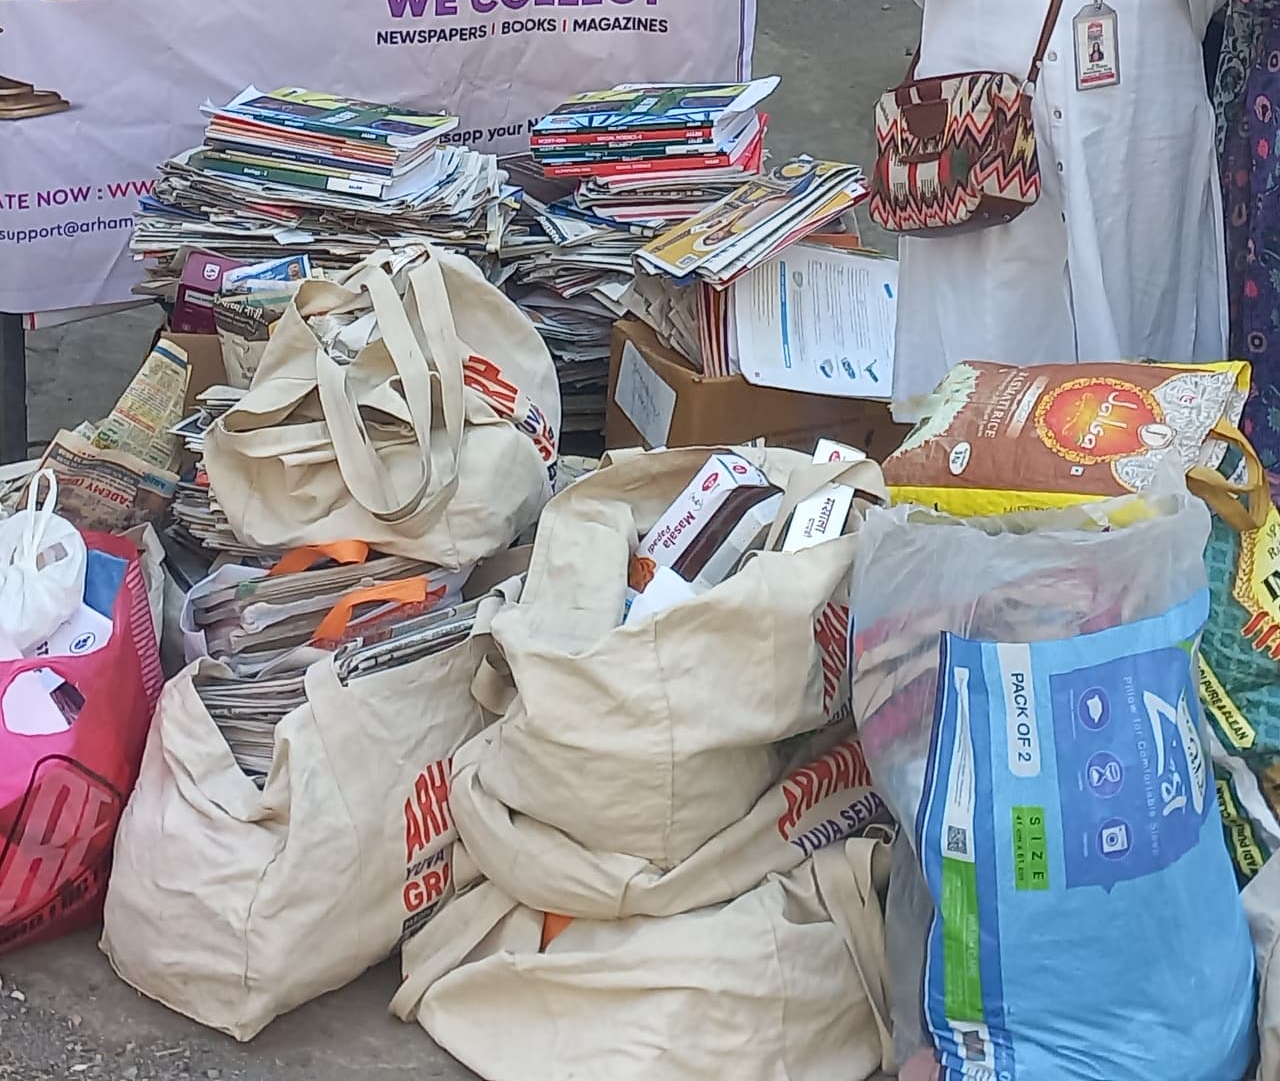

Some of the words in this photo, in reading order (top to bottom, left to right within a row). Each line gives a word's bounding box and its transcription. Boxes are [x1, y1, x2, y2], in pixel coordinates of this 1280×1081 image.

[376, 24, 488, 46] NEWSPAPERS
[501, 18, 557, 35] BOOKS
[573, 16, 669, 33] MAGAZINES
[487, 122, 525, 144] your
[37, 186, 91, 207] NOW
[109, 179, 154, 197] WW
[984, 406, 1007, 439] RICE
[1080, 391, 1138, 449] Jalsa
[663, 510, 696, 550] Masala
[1010, 671, 1031, 720] PACK
[1205, 678, 1223, 705] PURE
[1016, 721, 1032, 750] OF
[1018, 751, 1032, 763] 2
[404, 757, 454, 865] ARH
[790, 819, 844, 857] YUVA
[839, 790, 888, 829] SEVA
